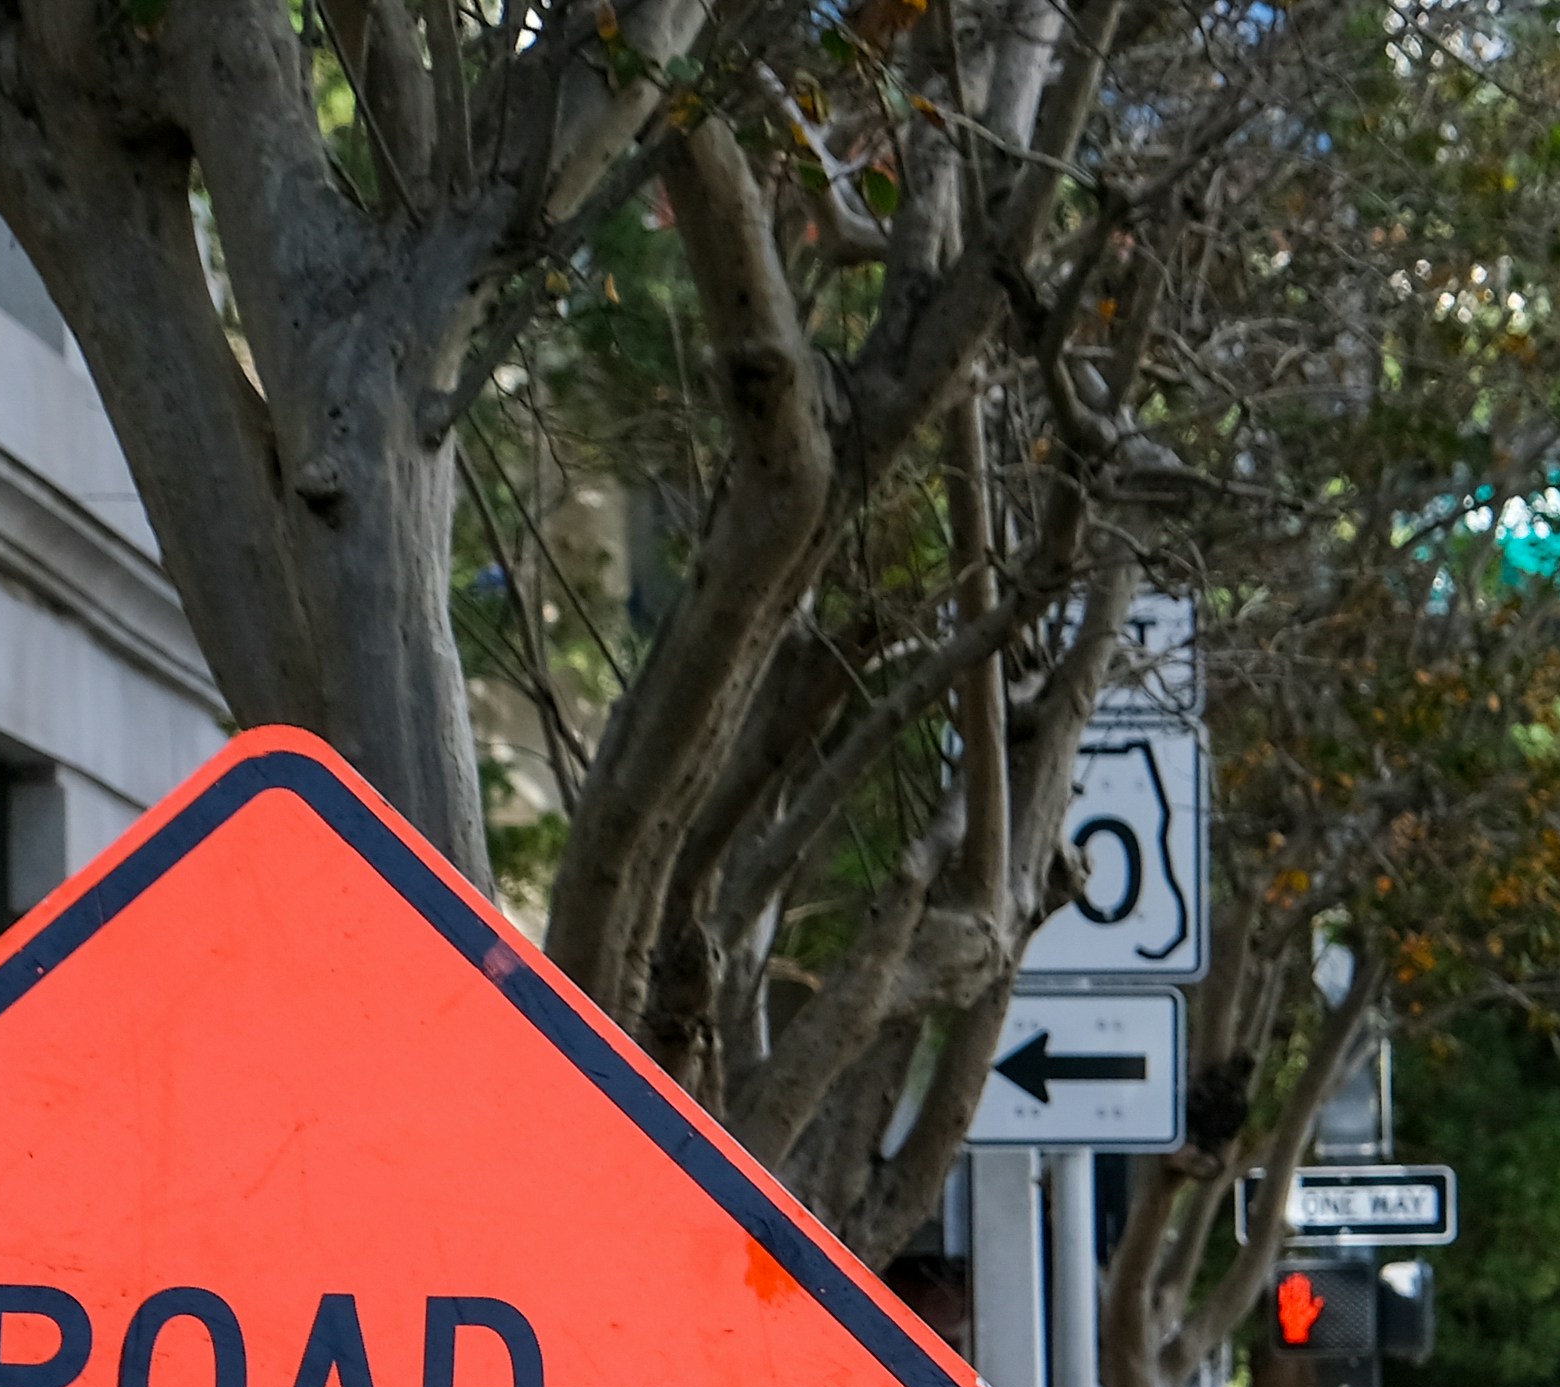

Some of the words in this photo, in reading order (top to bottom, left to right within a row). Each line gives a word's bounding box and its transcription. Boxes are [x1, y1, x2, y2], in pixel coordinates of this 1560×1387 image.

[1073, 815, 1141, 925] 0
[1302, 1189, 1357, 1222] ONE
[1368, 1186, 1427, 1220] WAY
